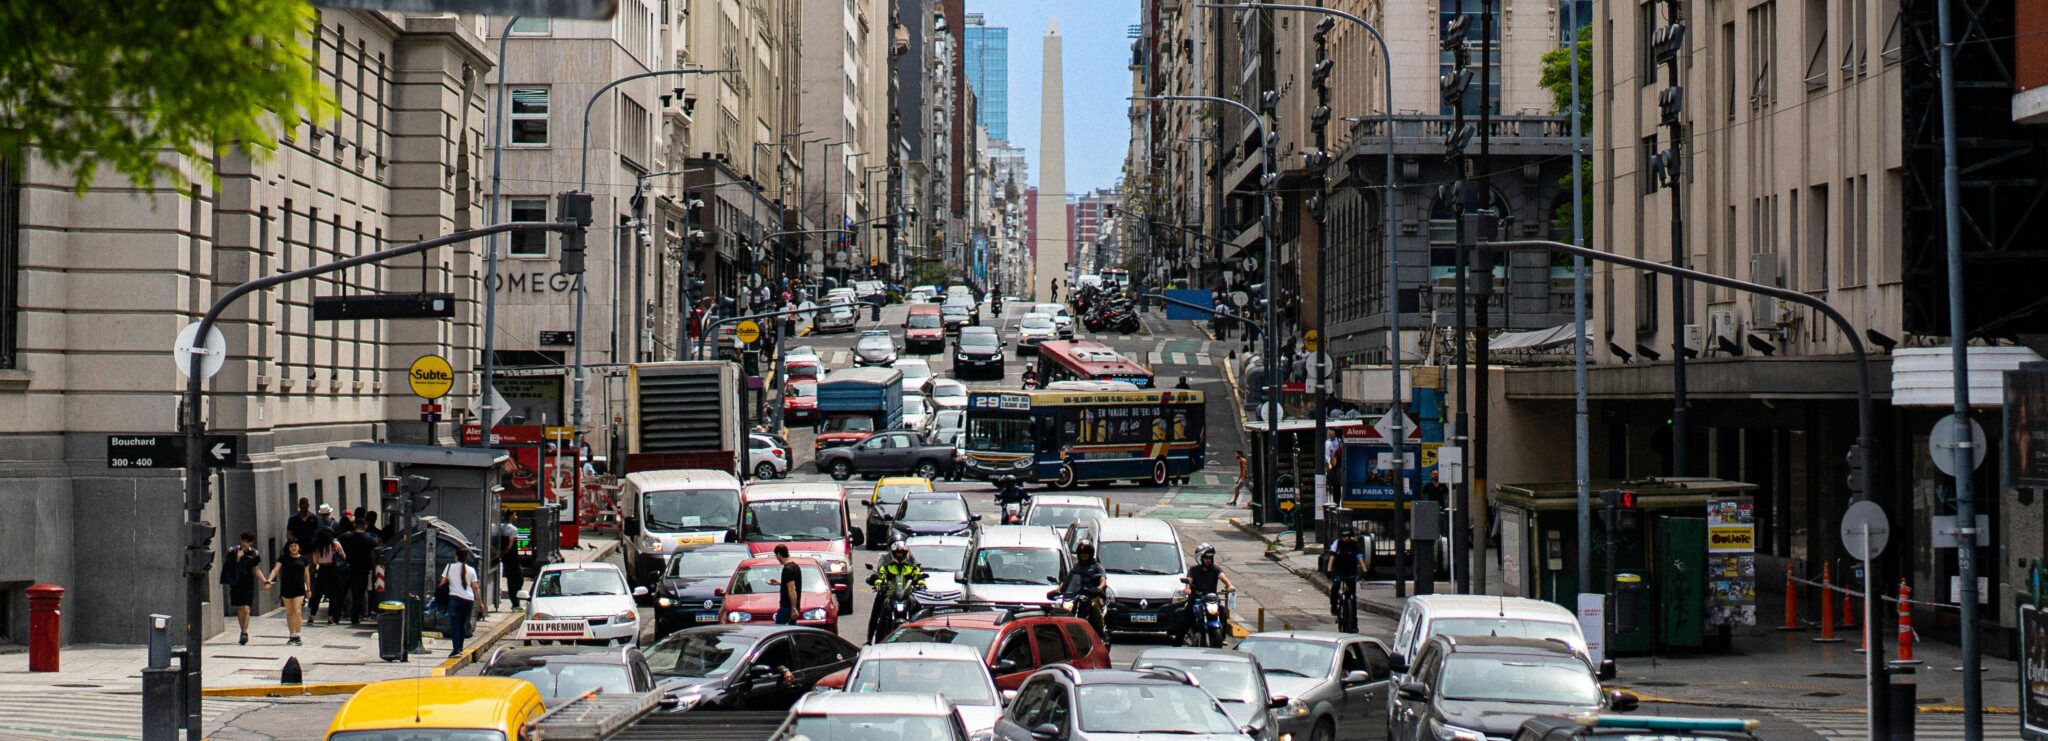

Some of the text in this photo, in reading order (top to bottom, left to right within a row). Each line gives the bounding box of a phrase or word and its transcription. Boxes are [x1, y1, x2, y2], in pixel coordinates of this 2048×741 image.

[415, 369, 448, 380] Subte
[976, 396, 999, 408] 29
[1346, 427, 1367, 435] Alem
[112, 437, 156, 446] Bouchard
[112, 458, 128, 466] 300
[136, 458, 153, 466] 400
[1351, 488, 1414, 496] ES PARA TOS
[527, 622, 585, 632] TAXI PREMIUM
